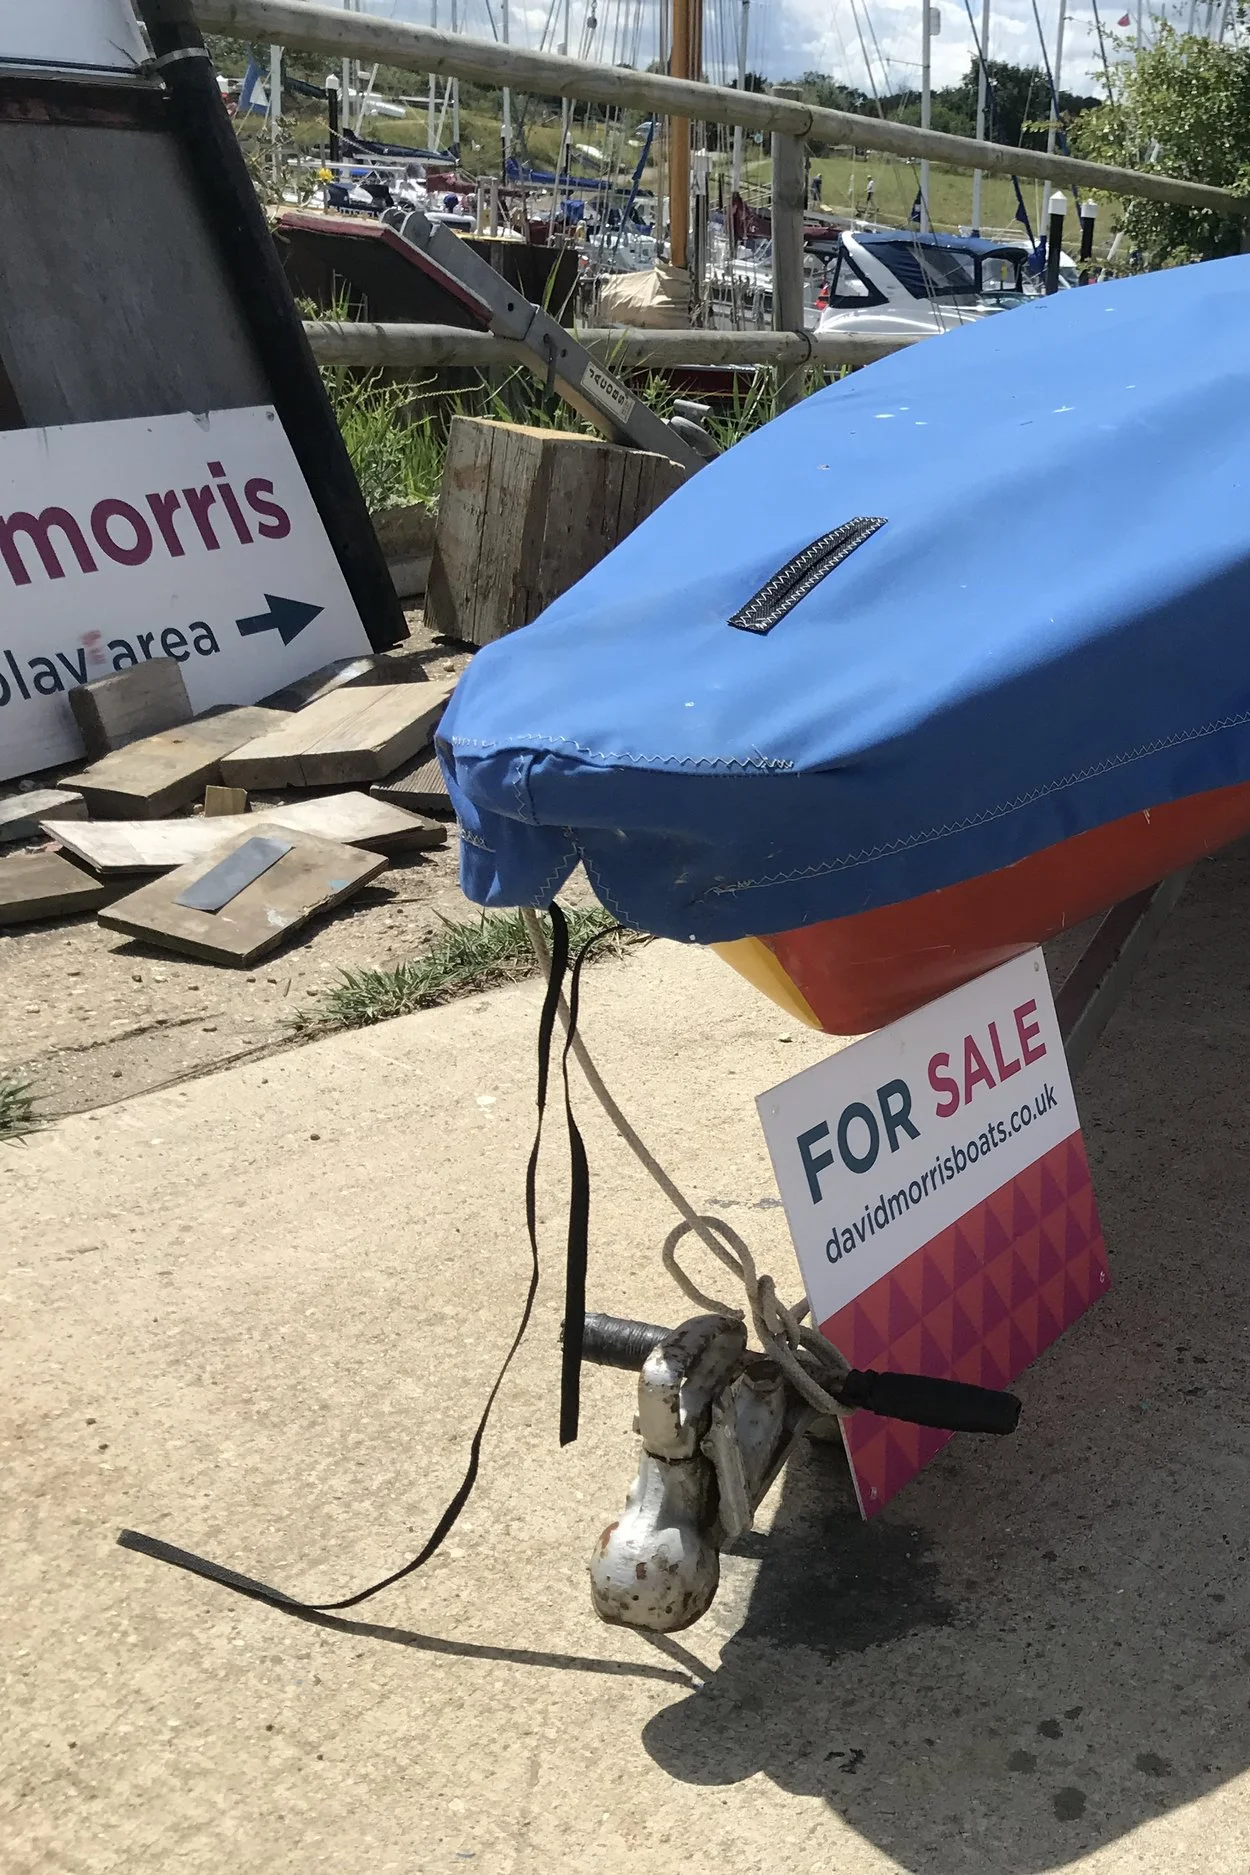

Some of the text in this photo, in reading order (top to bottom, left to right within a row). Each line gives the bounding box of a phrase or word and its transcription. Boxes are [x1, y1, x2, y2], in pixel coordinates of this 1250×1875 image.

[589, 368, 625, 406] JACOBS
[0, 461, 291, 586] morris
[107, 621, 221, 673] area
[796, 998, 1047, 1205] FOR SALE
[825, 1083, 1058, 1264] davidmorrisboats.co.uk
